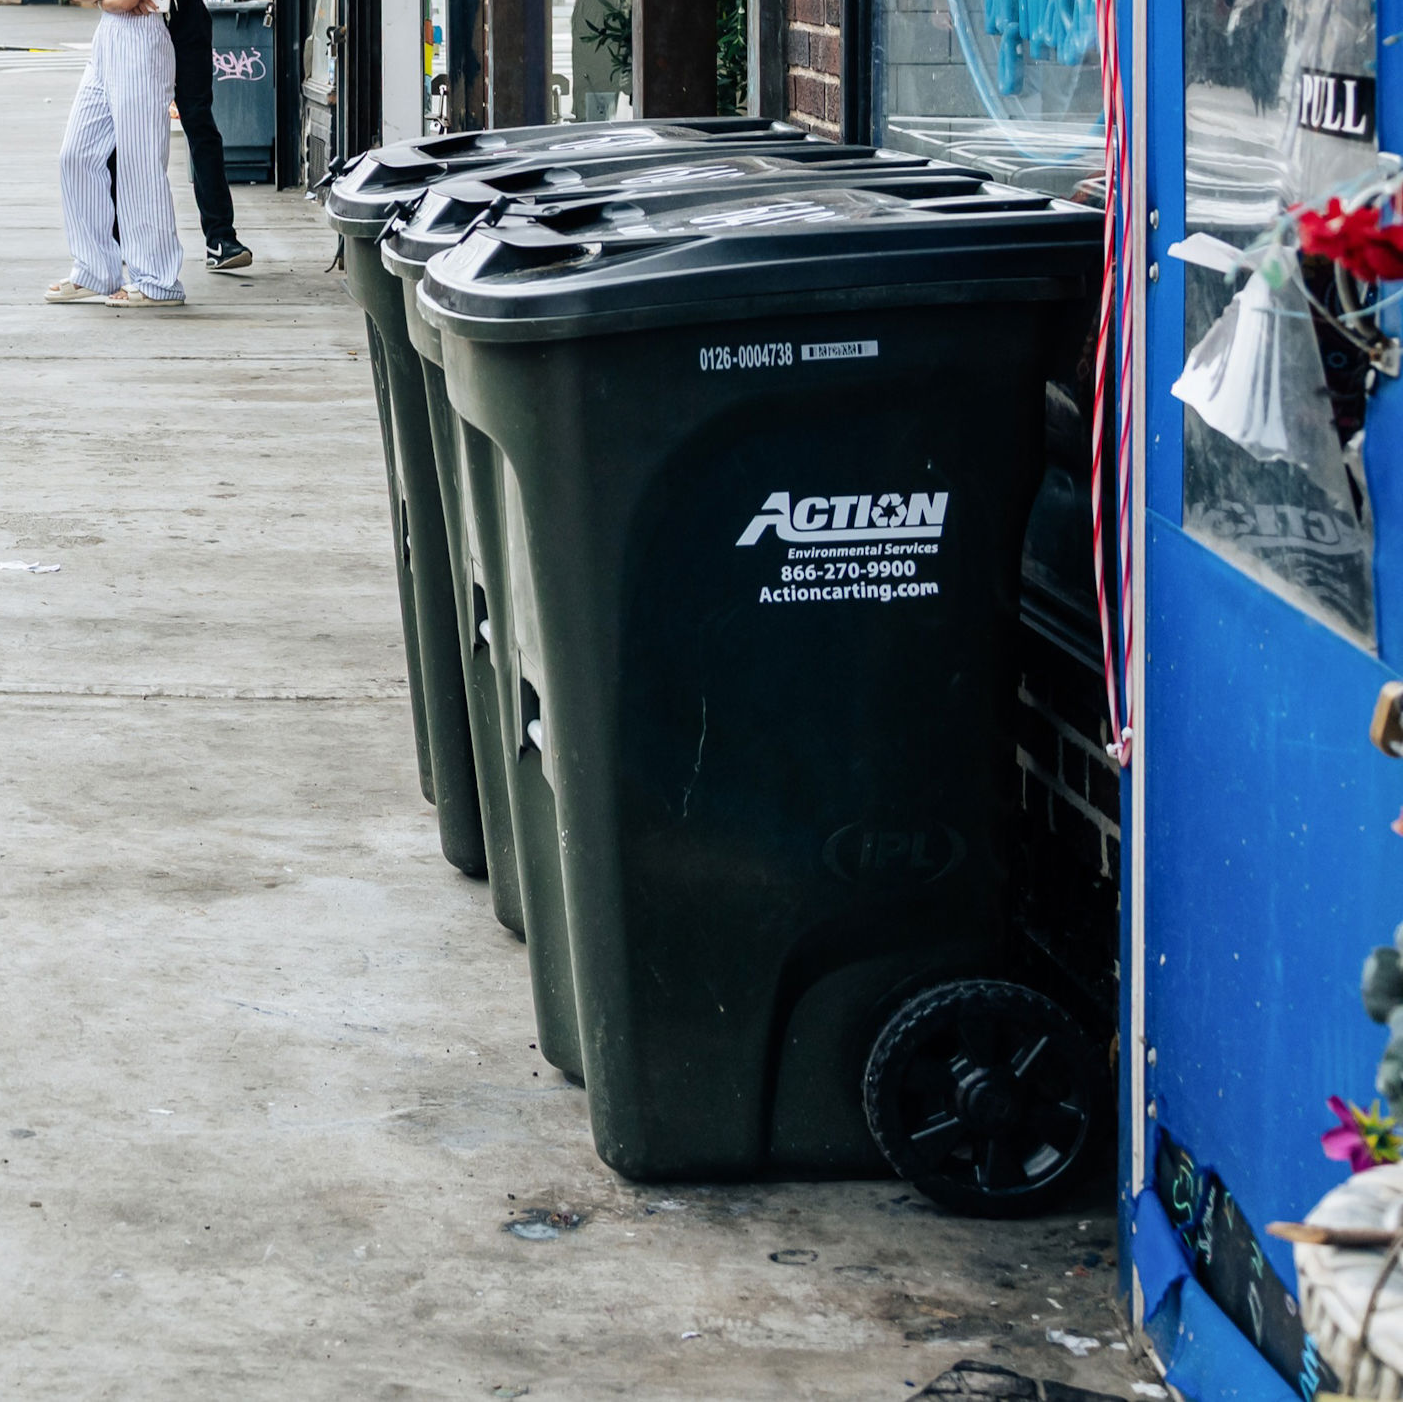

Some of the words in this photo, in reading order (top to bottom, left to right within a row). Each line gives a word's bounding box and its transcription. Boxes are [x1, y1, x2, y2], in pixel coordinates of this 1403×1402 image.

[1300, 74, 1367, 134] PULL
[699, 342, 793, 371] 0126-0004738
[735, 491, 949, 546] ACTION
[788, 543, 883, 560] Environmental
[883, 542, 939, 555] Services
[781, 560, 916, 582] 866-270-9900
[759, 581, 939, 604] Actioncarting.com
